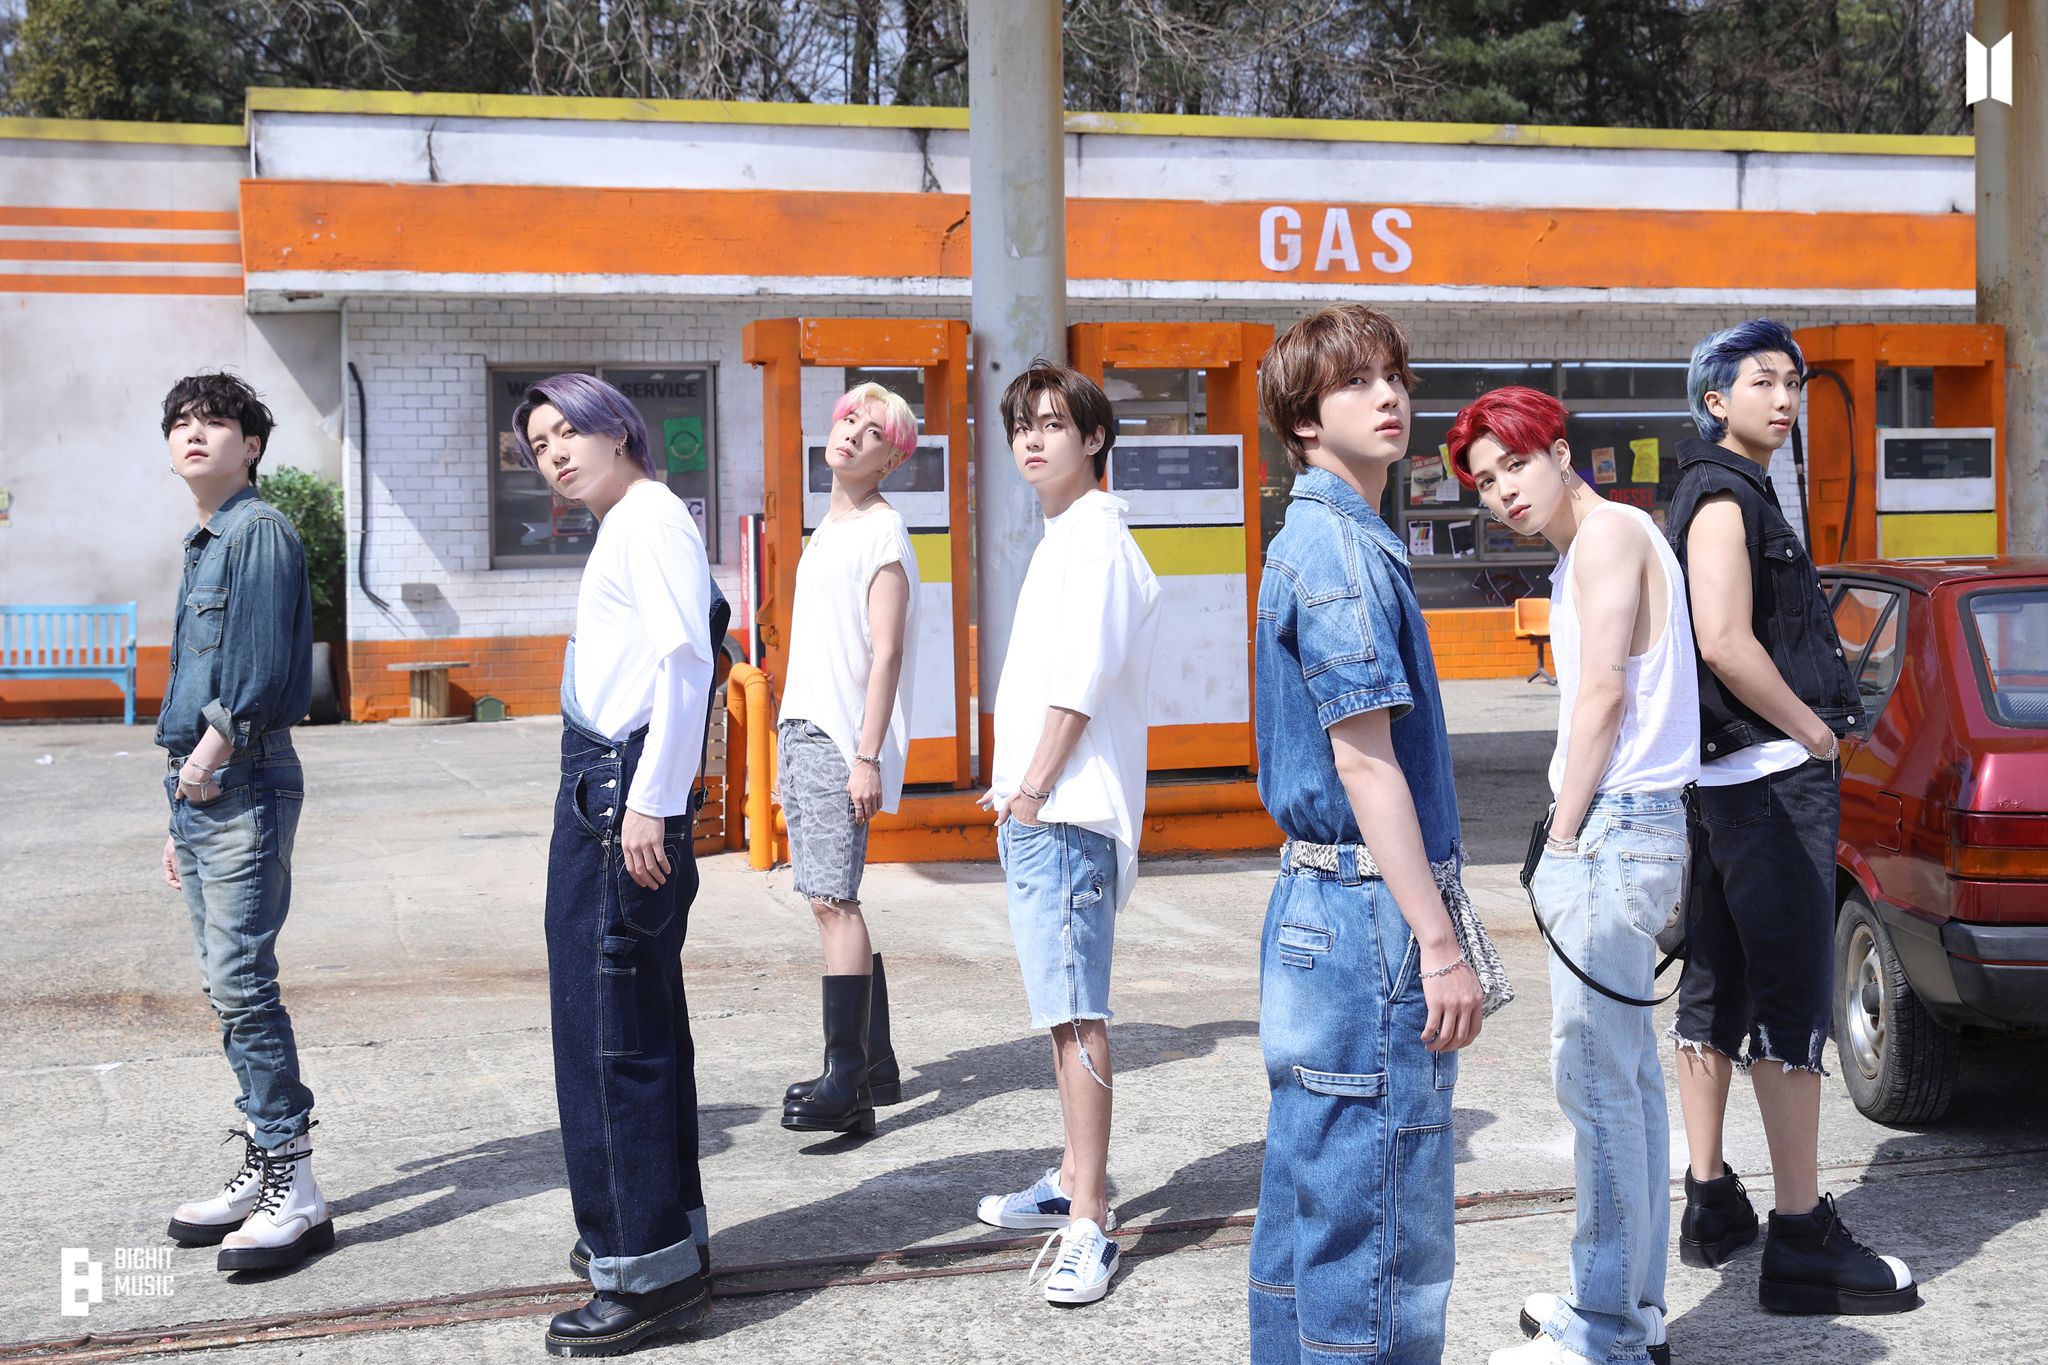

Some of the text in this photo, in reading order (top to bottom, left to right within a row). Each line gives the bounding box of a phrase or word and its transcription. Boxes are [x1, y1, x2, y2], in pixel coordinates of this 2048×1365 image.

[1259, 205, 1413, 273] GAS
[620, 382, 697, 398] SERVICE
[1609, 488, 1656, 508] DIESEL
